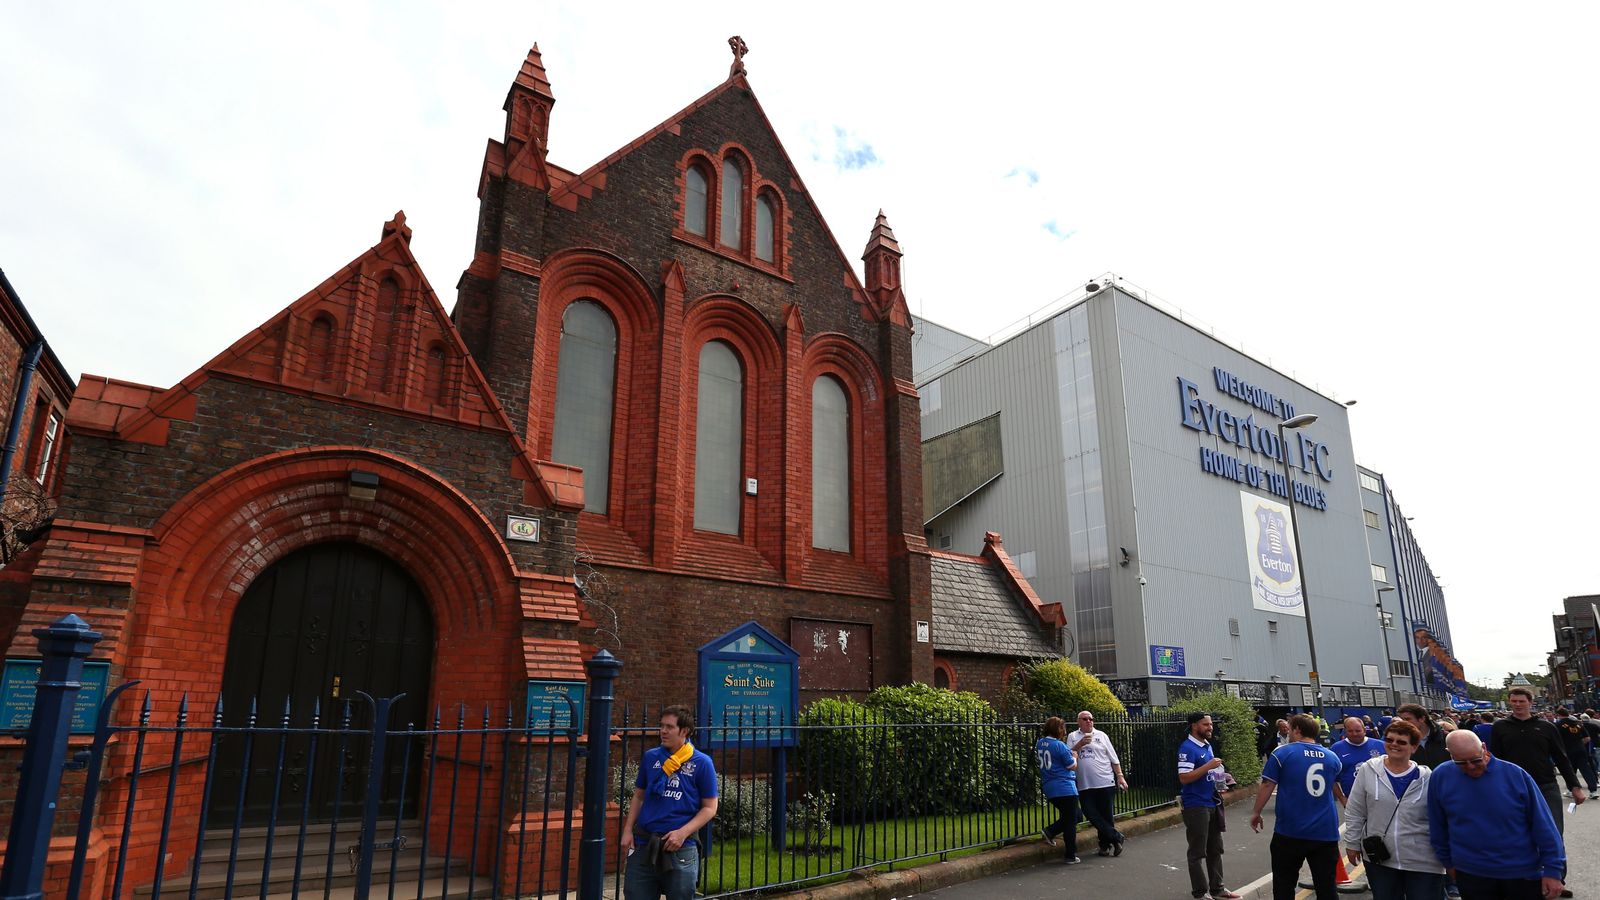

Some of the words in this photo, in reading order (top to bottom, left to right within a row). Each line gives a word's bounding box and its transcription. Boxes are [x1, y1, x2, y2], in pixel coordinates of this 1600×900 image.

[1213, 366, 1279, 416] WELCOME
[1280, 399, 1296, 420] TO
[1177, 376, 1295, 467] Everton
[1297, 431, 1333, 482] FC
[1200, 446, 1244, 483] HOME
[1246, 463, 1264, 488] OF
[1292, 479, 1328, 512] BLUES
[1261, 554, 1292, 574] Everton
[724, 673, 750, 688] Saint
[752, 675, 775, 689] Luke
[1037, 749, 1052, 770] 50
[1304, 749, 1325, 758] REID
[1305, 762, 1326, 797] 6
[661, 789, 683, 800] ang
